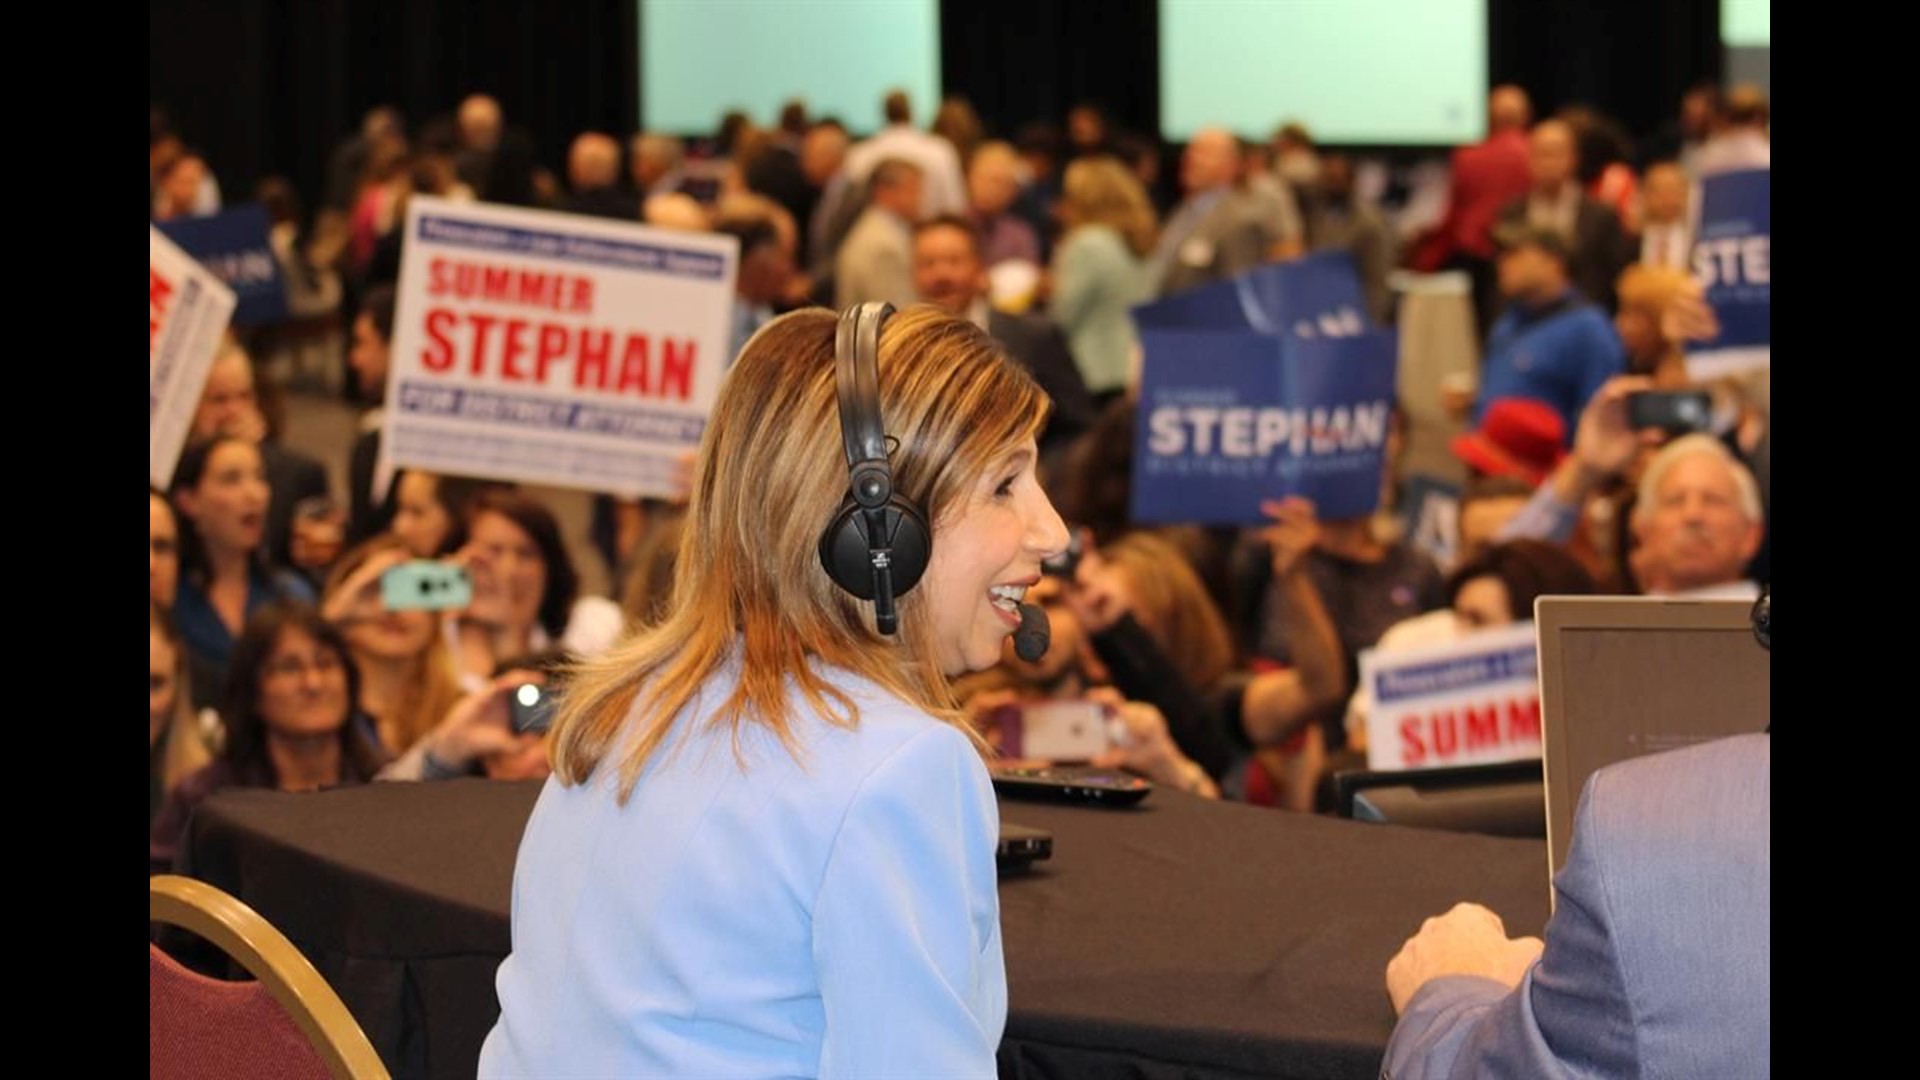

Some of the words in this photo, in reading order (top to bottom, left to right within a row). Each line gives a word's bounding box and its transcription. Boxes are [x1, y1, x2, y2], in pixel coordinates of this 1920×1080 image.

[427, 257, 596, 313] SUMMER
[420, 308, 697, 403] STEPHAN
[1148, 400, 1388, 456] STEPHAN
